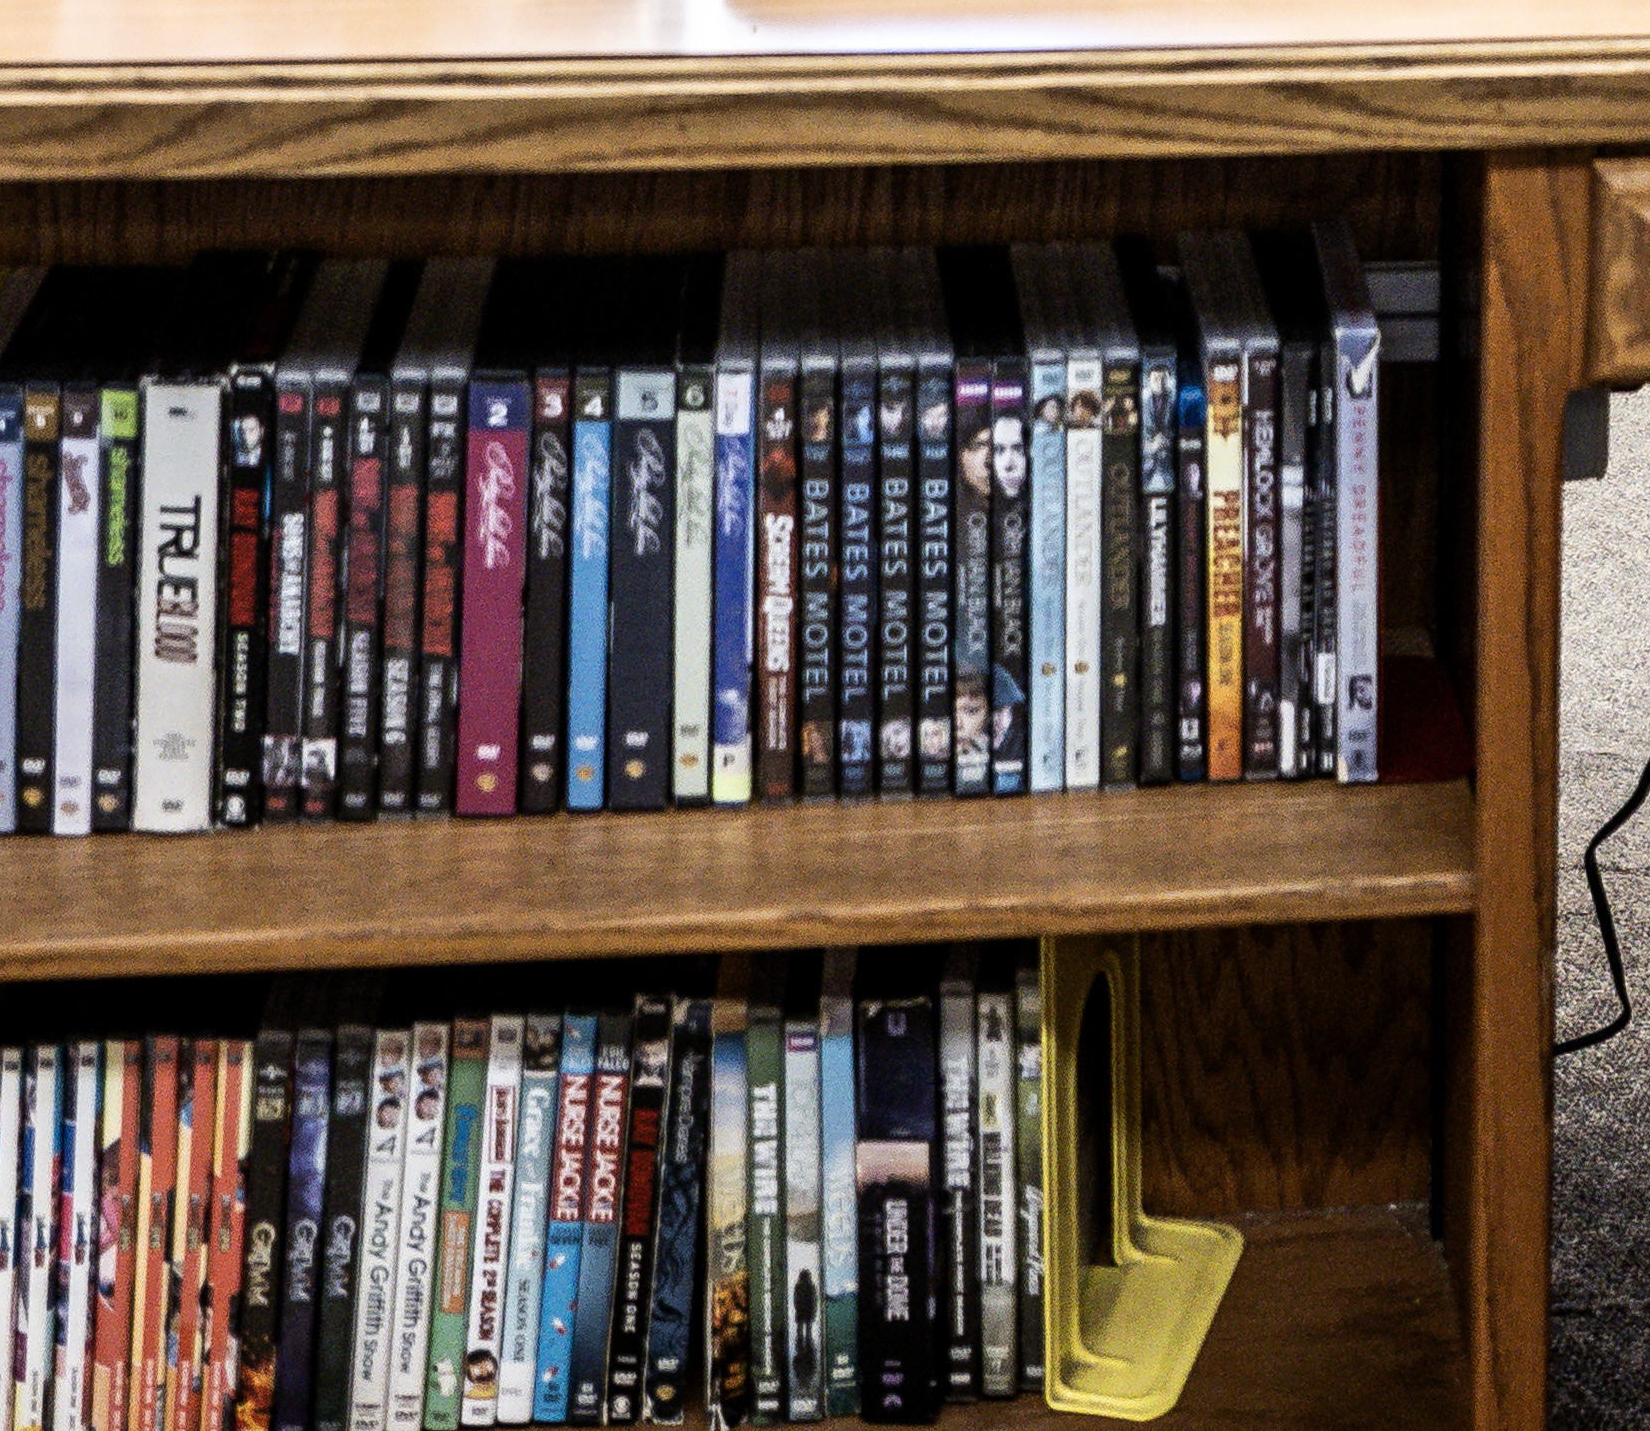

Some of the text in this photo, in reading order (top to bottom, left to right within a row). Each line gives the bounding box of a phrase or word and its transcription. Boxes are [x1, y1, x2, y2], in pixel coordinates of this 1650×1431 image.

[487, 400, 508, 429] 2
[543, 392, 564, 420] 3
[583, 394, 603, 418] 4
[1350, 405, 1367, 479] PENNY
[24, 453, 51, 611] shameless
[105, 447, 132, 566] shameless
[1110, 463, 1130, 611] OUTLANDER
[1215, 490, 1239, 619] PREACHER
[1255, 409, 1275, 603] HEMLOCK GROVE
[802, 479, 830, 704] BATES MOTEL
[841, 482, 869, 704] BATES MOTEL
[882, 478, 909, 702] BATES MOTEL
[922, 479, 950, 702] BATES MOTEL
[966, 512, 988, 656] ORPHAN BLACK
[1000, 510, 1022, 656] ORPHAN BLACK
[557, 1073, 587, 1221] NURSE JACKIE
[593, 1075, 622, 1221] NURSE JACKIE
[983, 1131, 1002, 1237] WALKING DEAD
[622, 1303, 639, 1334] ONE
[625, 1242, 643, 1299] SEASON
